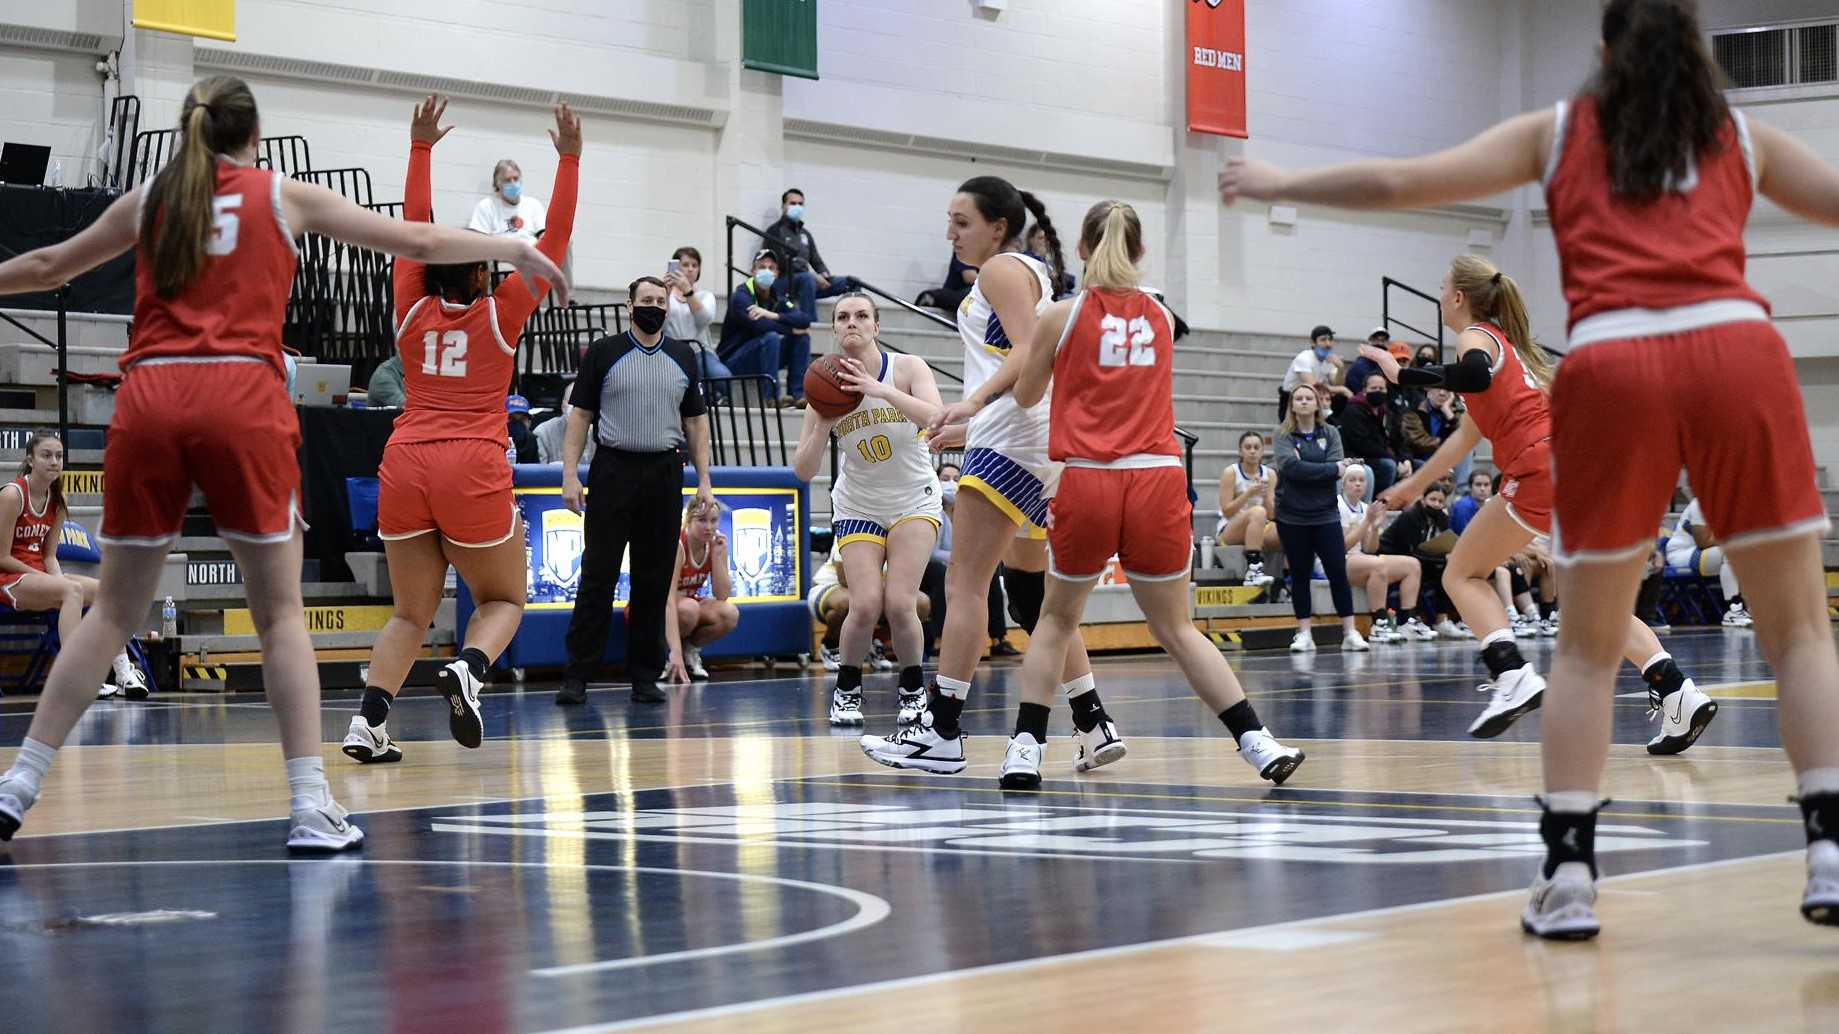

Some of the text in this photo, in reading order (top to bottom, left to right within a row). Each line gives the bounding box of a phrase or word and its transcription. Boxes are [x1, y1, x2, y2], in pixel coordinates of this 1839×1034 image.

[1194, 47, 1242, 71] RED MEN
[207, 193, 244, 256] 5
[1099, 313, 1156, 367] 22
[422, 329, 468, 378] 12
[857, 434, 893, 463] 10
[62, 474, 104, 493] IKIN
[188, 564, 236, 584] NORTH
[1197, 589, 1234, 605] VIKINGS
